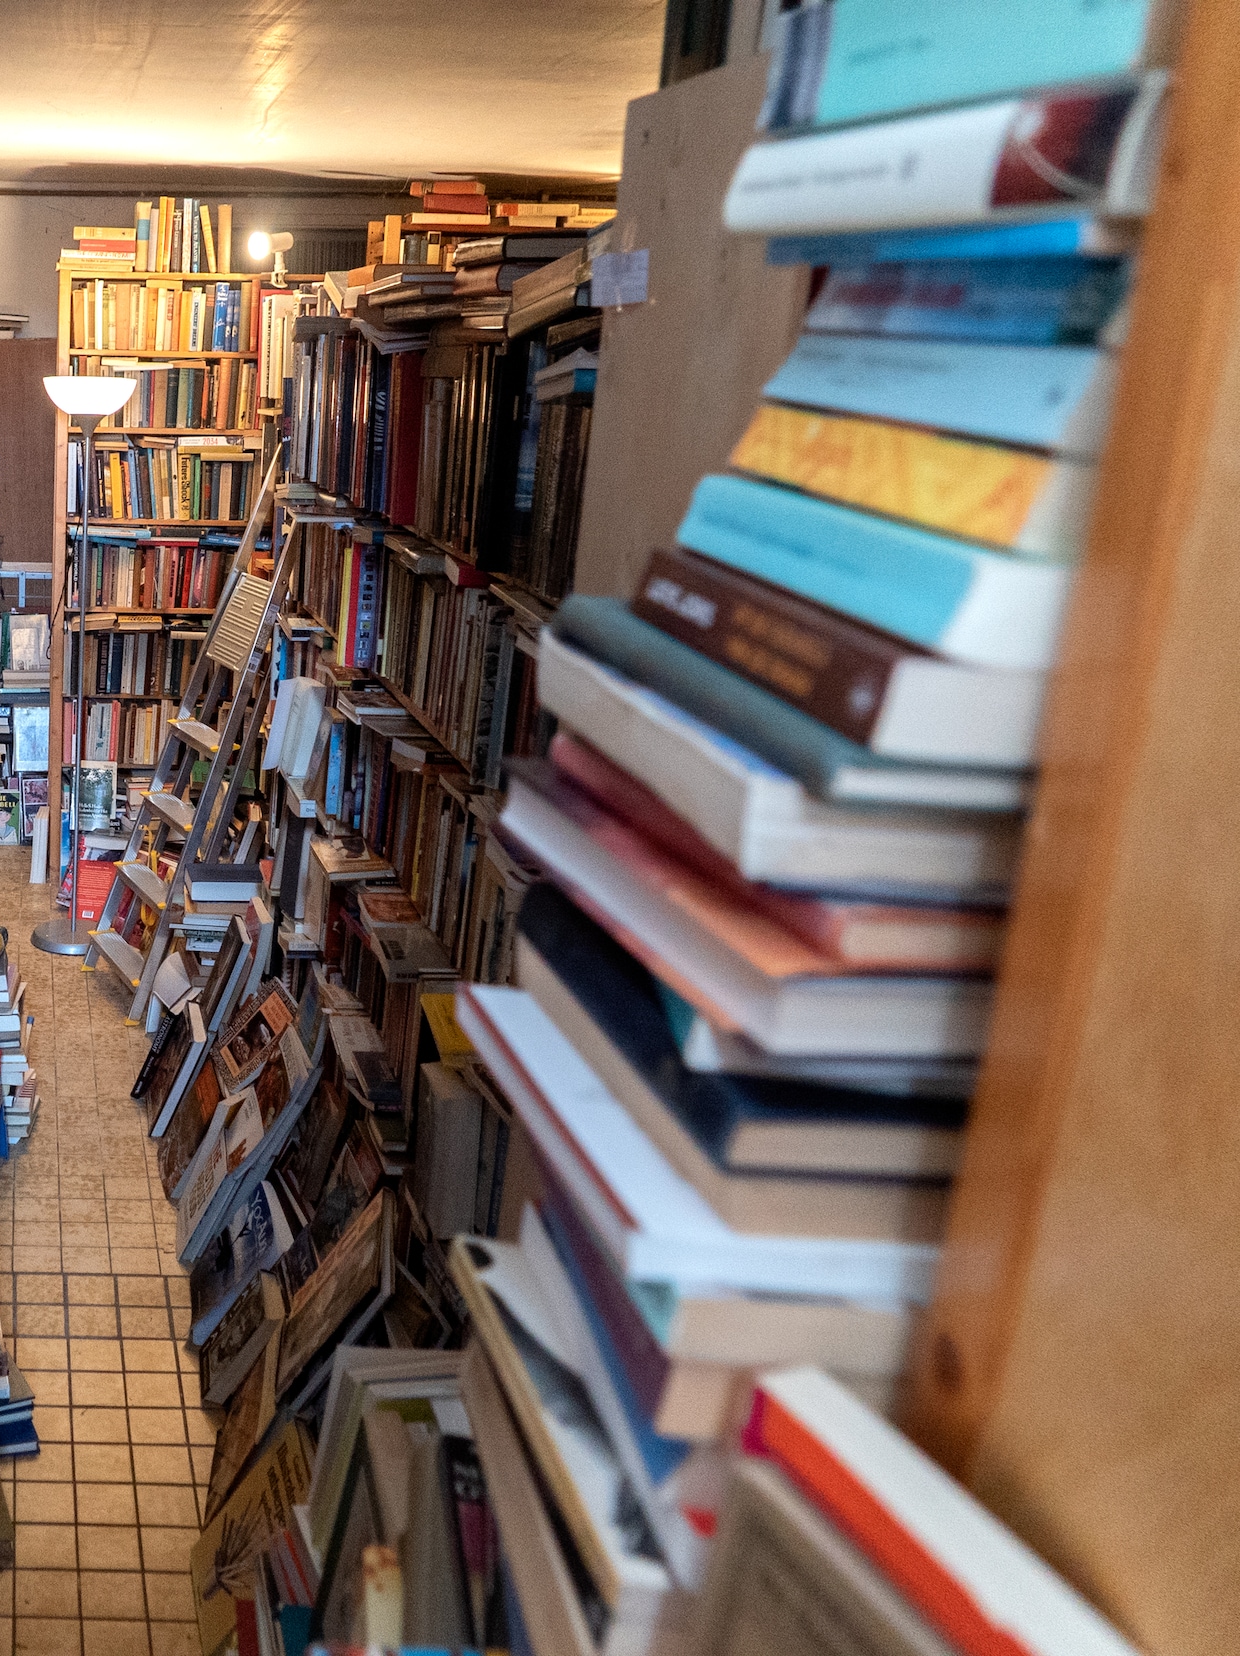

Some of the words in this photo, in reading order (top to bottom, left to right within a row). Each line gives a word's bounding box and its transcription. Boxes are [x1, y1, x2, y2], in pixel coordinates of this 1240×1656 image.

[202, 437, 218, 445] 2034
[181, 480, 191, 504] Shock
[150, 1014, 172, 1053] ASTRONOMY
